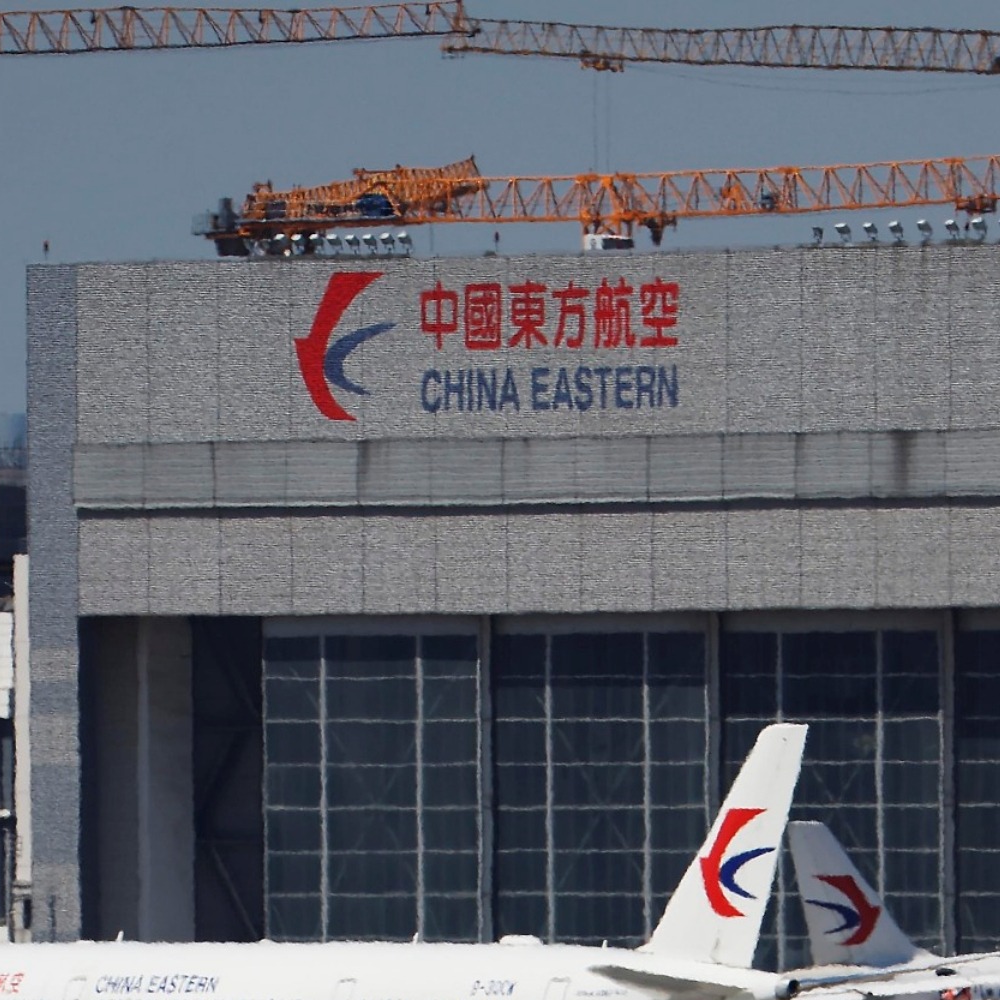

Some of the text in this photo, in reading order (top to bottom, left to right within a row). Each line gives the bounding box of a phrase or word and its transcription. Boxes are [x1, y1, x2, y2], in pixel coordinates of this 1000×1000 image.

[420, 278, 680, 350] 中國東方航空
[421, 364, 679, 413] CHINA EASTERN
[95, 974, 220, 994] CHINA EASTERN
